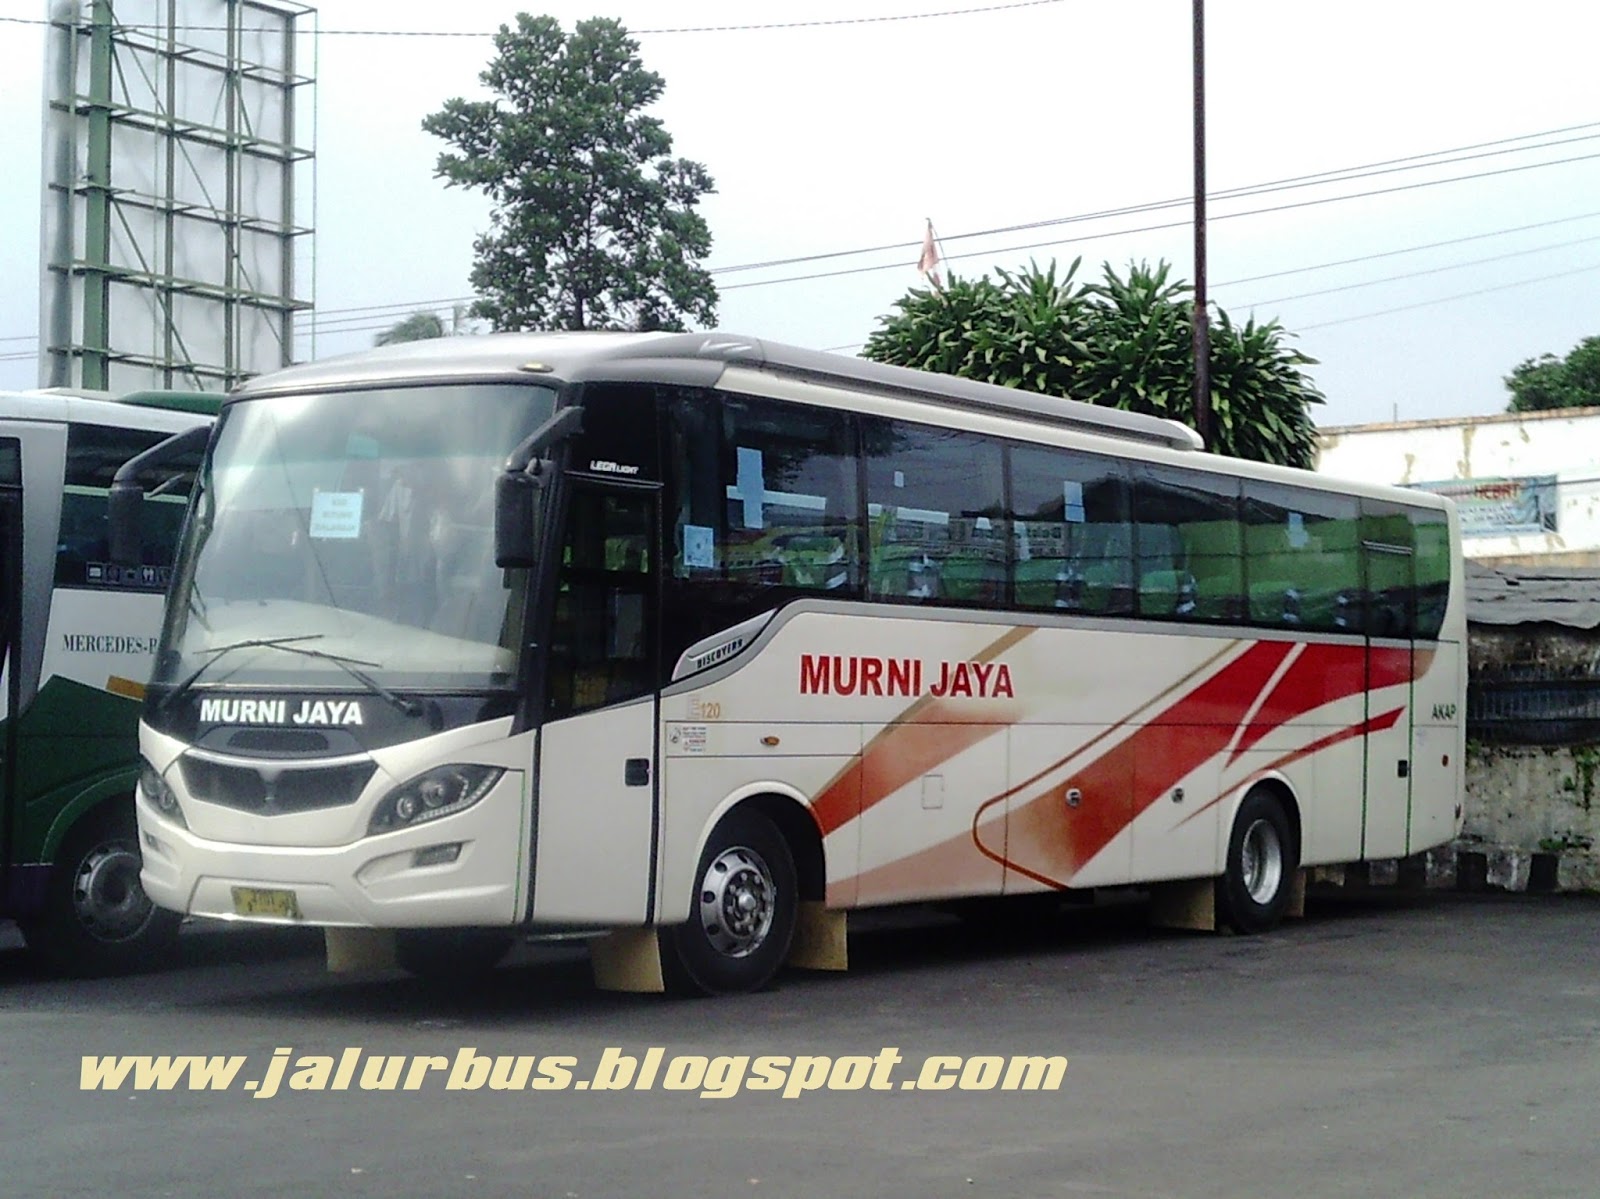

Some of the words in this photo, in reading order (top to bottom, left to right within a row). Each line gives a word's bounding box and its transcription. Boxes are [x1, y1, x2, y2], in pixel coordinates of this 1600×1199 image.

[799, 654, 922, 697] MURNI
[929, 661, 1015, 698] JAYA
[200, 699, 286, 723] MURNI
[292, 701, 363, 725] JAYA
[1432, 703, 1456, 719] AKAP
